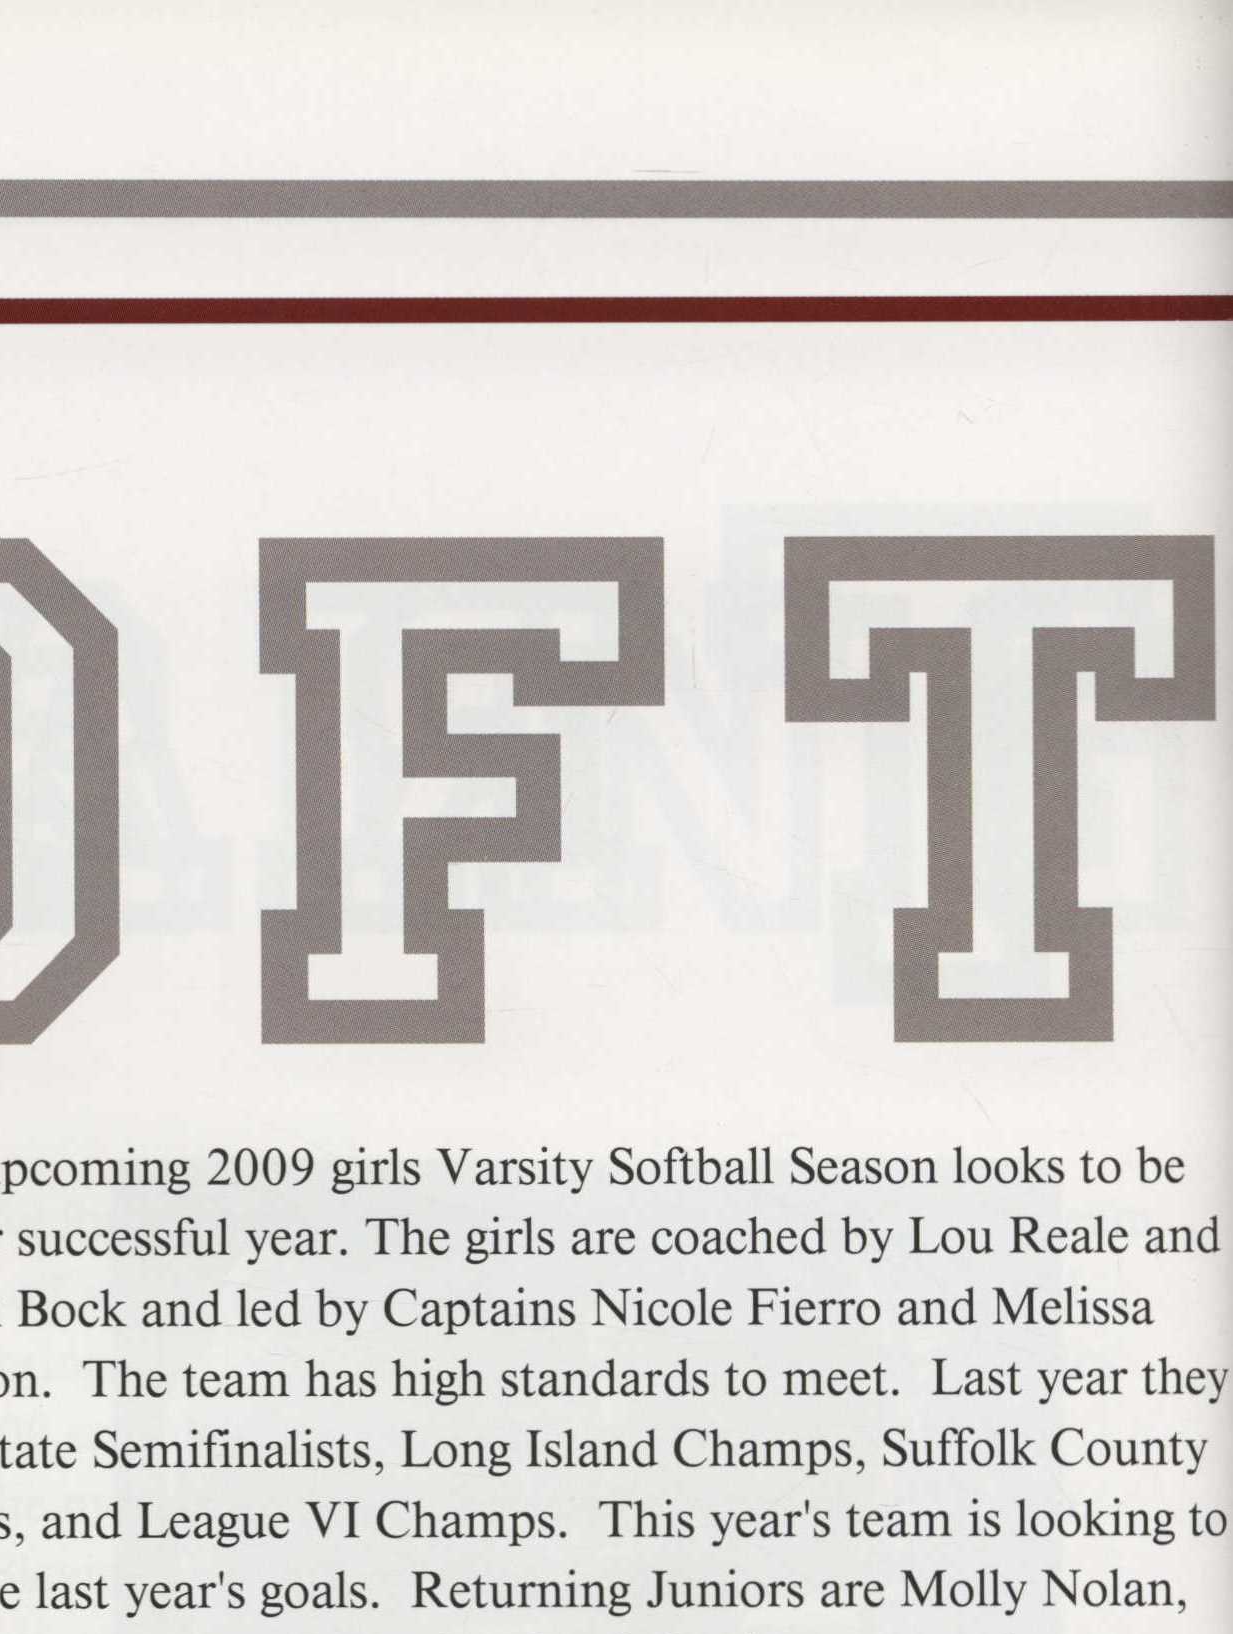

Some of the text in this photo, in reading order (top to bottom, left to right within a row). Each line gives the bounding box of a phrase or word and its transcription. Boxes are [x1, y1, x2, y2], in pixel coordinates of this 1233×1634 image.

[207, 1147, 314, 1186] 2009
[331, 1146, 421, 1195] girls
[436, 1146, 594, 1195] Varsity
[609, 1146, 774, 1186] Softball
[790, 1146, 938, 1185] Season
[953, 1145, 1065, 1185] looks
[1080, 1151, 1121, 1184] to
[1136, 1145, 1185, 1184] be
[18, 1216, 230, 1257] successful
[244, 1228, 348, 1266] year.
[365, 1217, 450, 1256] The
[465, 1216, 555, 1265] girls
[571, 1227, 636, 1256] are
[651, 1215, 827, 1256] coached
[841, 1215, 894, 1264] by
[909, 1216, 994, 1255] Lou
[1010, 1215, 1129, 1254] Reale
[1145, 1215, 1221, 1254] and
[18, 1288, 127, 1328] Bock
[142, 1288, 222, 1328] and
[236, 1288, 302, 1328] led
[315, 1288, 369, 1337] by
[383, 1286, 576, 1336] Captains
[590, 1286, 732, 1327] Nicole
[748, 1286, 881, 1326] Fierro
[897, 1286, 977, 1326] and
[992, 1285, 1154, 1326] Melissa
[82, 1359, 168, 1398] The
[182, 1364, 290, 1398] team
[305, 1358, 377, 1398] has
[391, 1357, 485, 1407] high
[501, 1358, 710, 1398] standards
[724, 1363, 767, 1397] to
[782, 1362, 900, 1397] meet.
[932, 1358, 1022, 1396] Last
[1037, 1368, 1128, 1405] year
[1141, 1356, 1229, 1405] they
[94, 1428, 384, 1476] Semifinalists,
[401, 1430, 512, 1477] Long
[526, 1428, 658, 1468] Island
[673, 1428, 865, 1476] Champs,
[883, 1426, 1036, 1467] Suffolk
[1051, 1427, 1208, 1475] County
[42, 1501, 122, 1540] and
[138, 1501, 290, 1548] League
[305, 1501, 360, 1538] VI
[376, 1500, 567, 1547] Champs.
[598, 1498, 695, 1538] This
[710, 1499, 831, 1547] year's
[845, 1505, 952, 1538] team
[968, 1497, 1001, 1538] is
[1016, 1497, 1176, 1546] looking
[1188, 1503, 1228, 1537] to
[36, 1571, 110, 1610] last
[124, 1570, 246, 1619] year's
[260, 1570, 379, 1618] goals.
[411, 1569, 632, 1617] Returning
[646, 1568, 804, 1609] Juniors
[820, 1580, 885, 1608] are
[901, 1568, 1027, 1616] Molly
[1042, 1568, 1186, 1614] Nolan,
